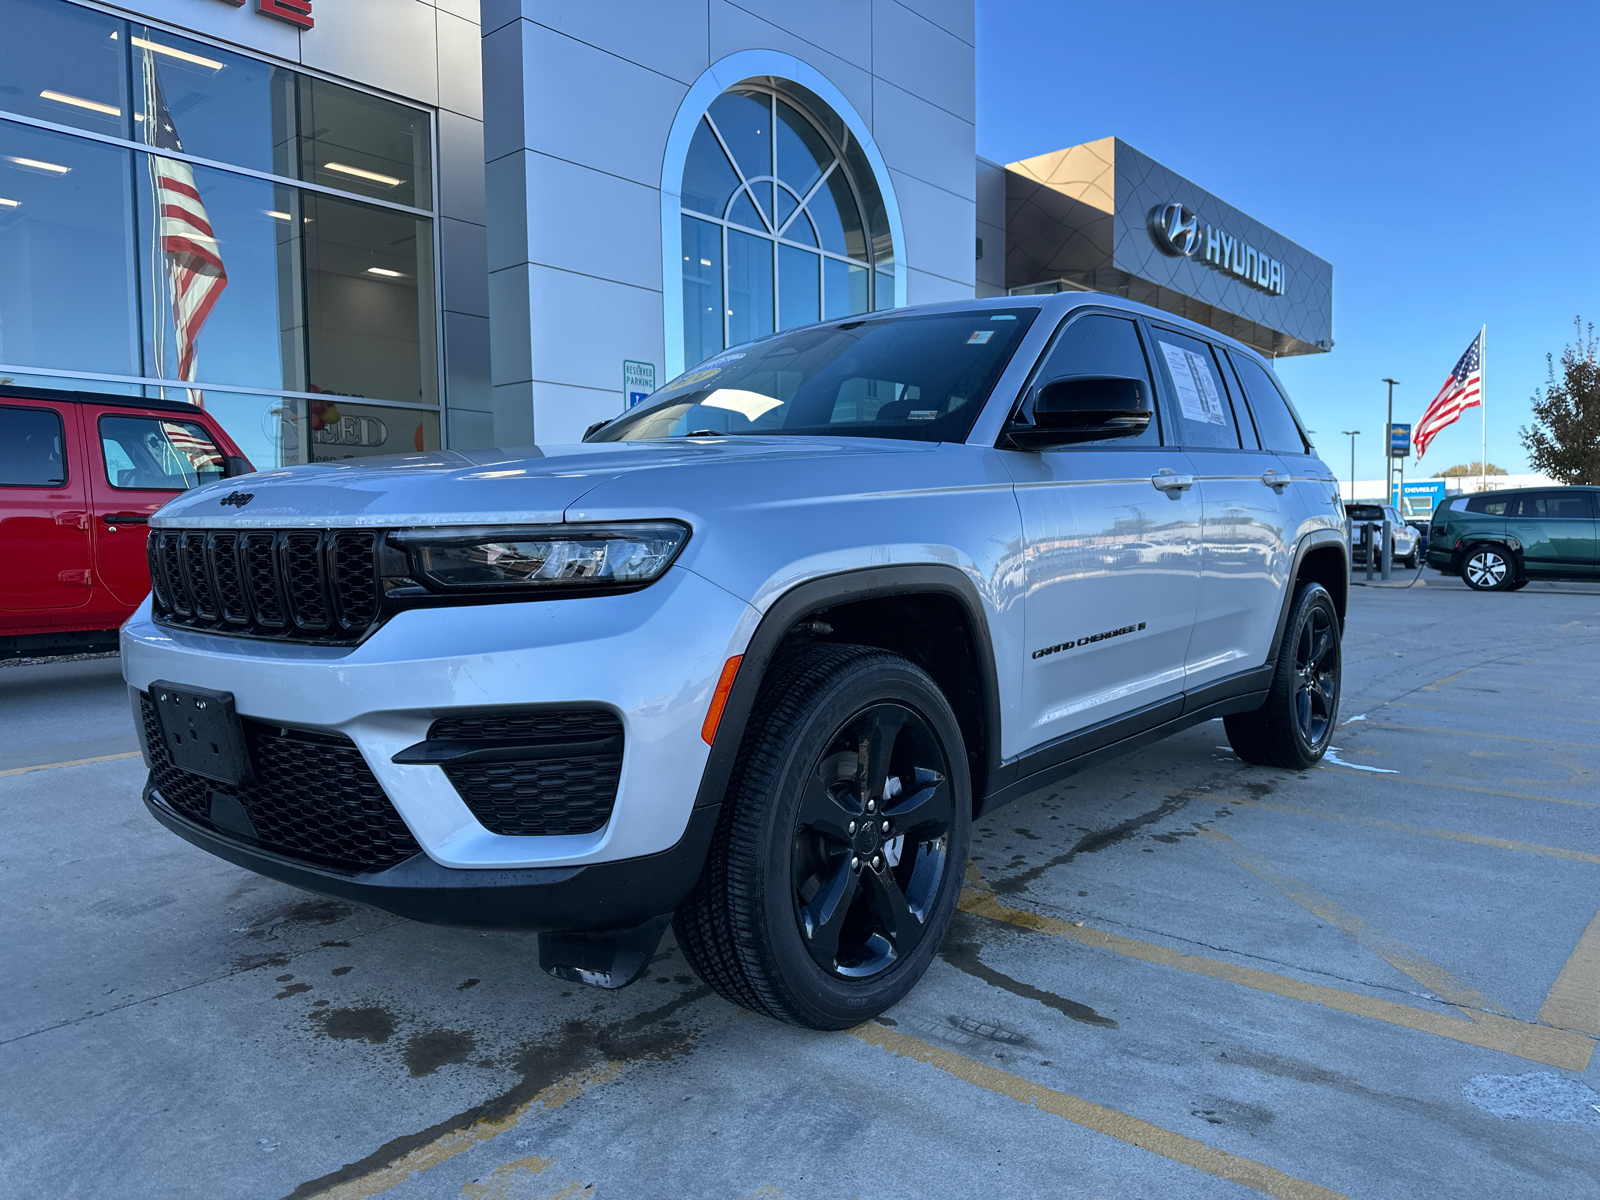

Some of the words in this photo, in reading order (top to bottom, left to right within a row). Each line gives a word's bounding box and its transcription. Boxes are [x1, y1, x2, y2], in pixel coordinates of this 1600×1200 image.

[1205, 223, 1286, 296] HYUNDAI
[626, 365, 653, 377] RESERVED
[626, 376, 653, 388] PARKING
[220, 490, 254, 508] Jeep
[1032, 641, 1075, 659] GRAND
[1077, 625, 1136, 646] CHEROKEE
